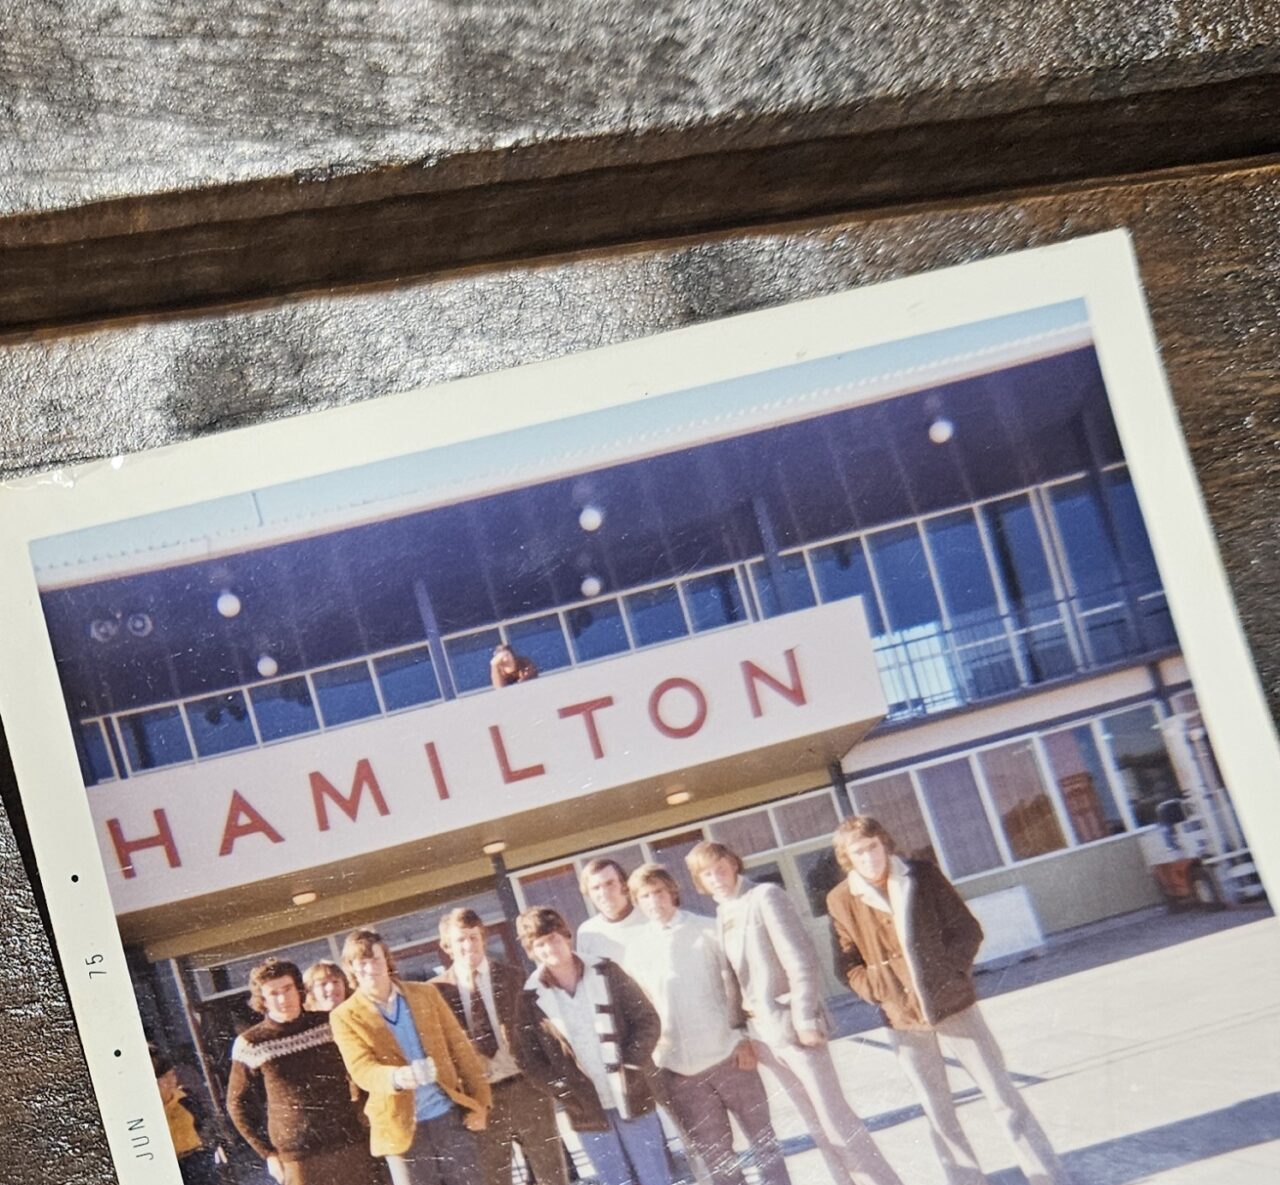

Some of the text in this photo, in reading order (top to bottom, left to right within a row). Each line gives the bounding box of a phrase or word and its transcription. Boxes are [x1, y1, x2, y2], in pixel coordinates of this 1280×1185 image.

[105, 648, 808, 879] HAMILTON
[84, 953, 154, 1161] JUN 75
